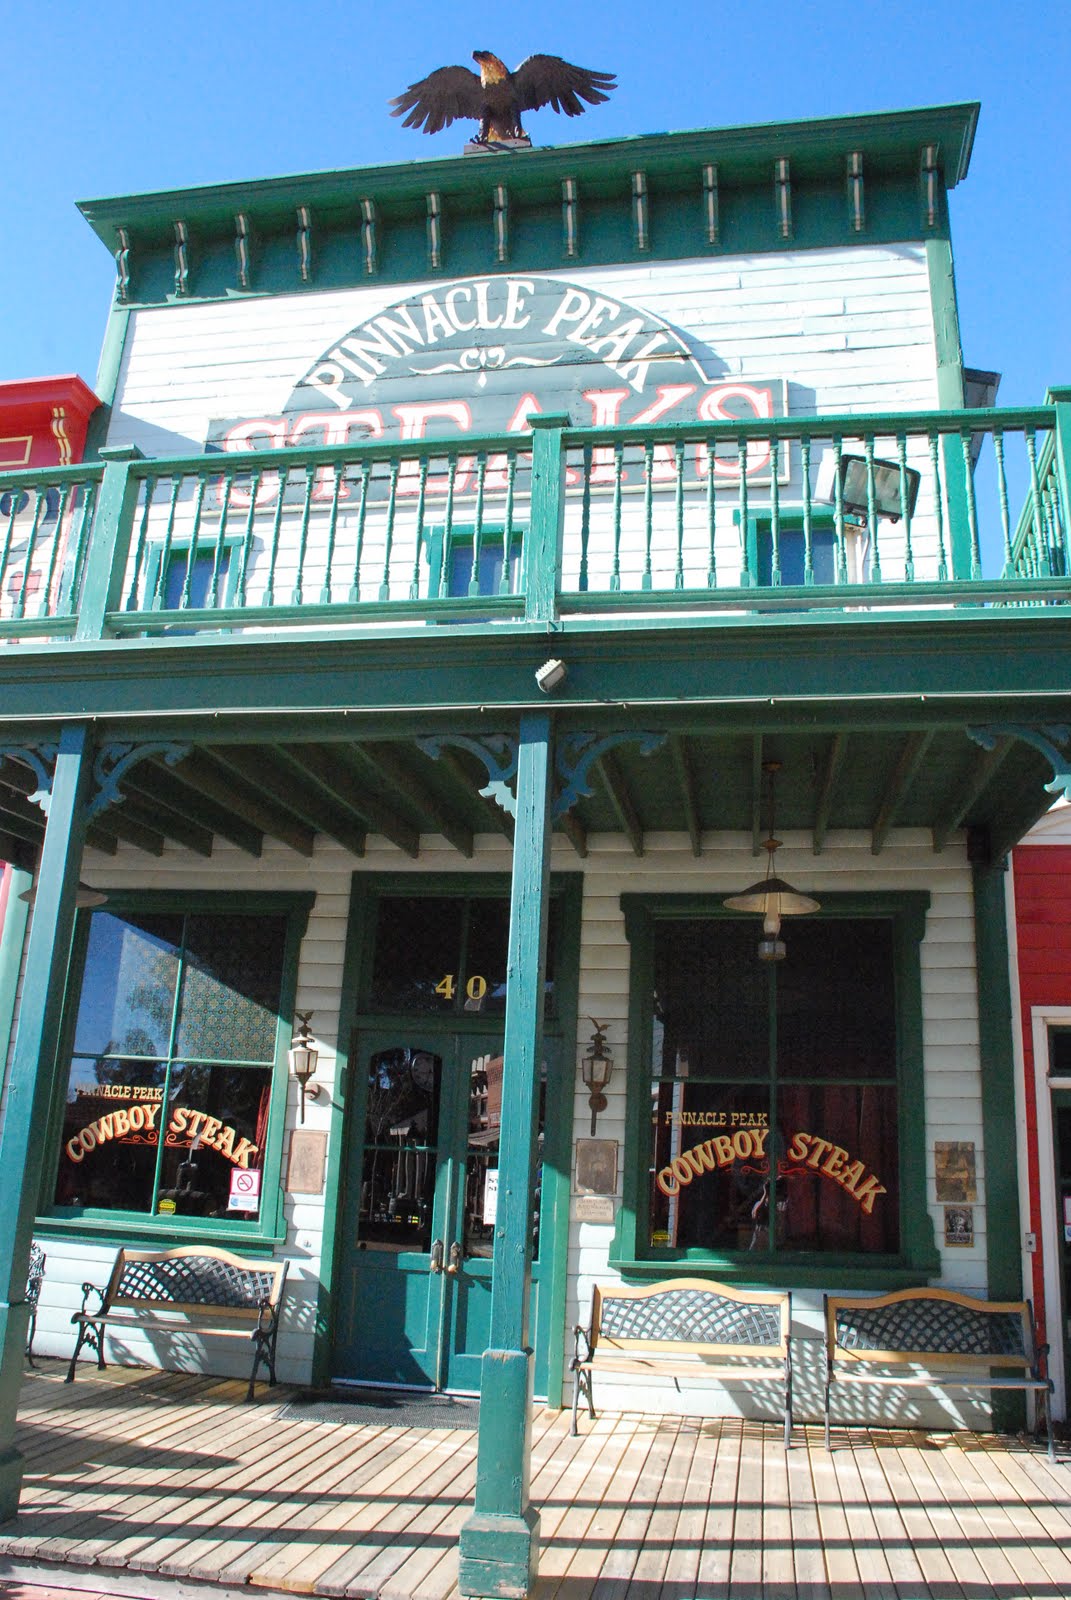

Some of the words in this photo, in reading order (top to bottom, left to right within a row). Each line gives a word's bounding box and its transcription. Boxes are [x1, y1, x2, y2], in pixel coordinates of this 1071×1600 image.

[306, 280, 536, 411] PINNACLE
[543, 287, 687, 393] PEAK
[217, 384, 774, 508] STEAKS
[435, 974, 487, 1000] 40
[76, 1083, 131, 1099] NACLE
[133, 1087, 163, 1101] PEAK
[665, 1111, 727, 1126] PNNACLE
[730, 1112, 768, 1126] PEAK
[66, 1104, 160, 1163] COWBOY
[169, 1108, 258, 1168] STEAK
[657, 1129, 769, 1196] COWBOY
[788, 1132, 887, 1213] STEAK
